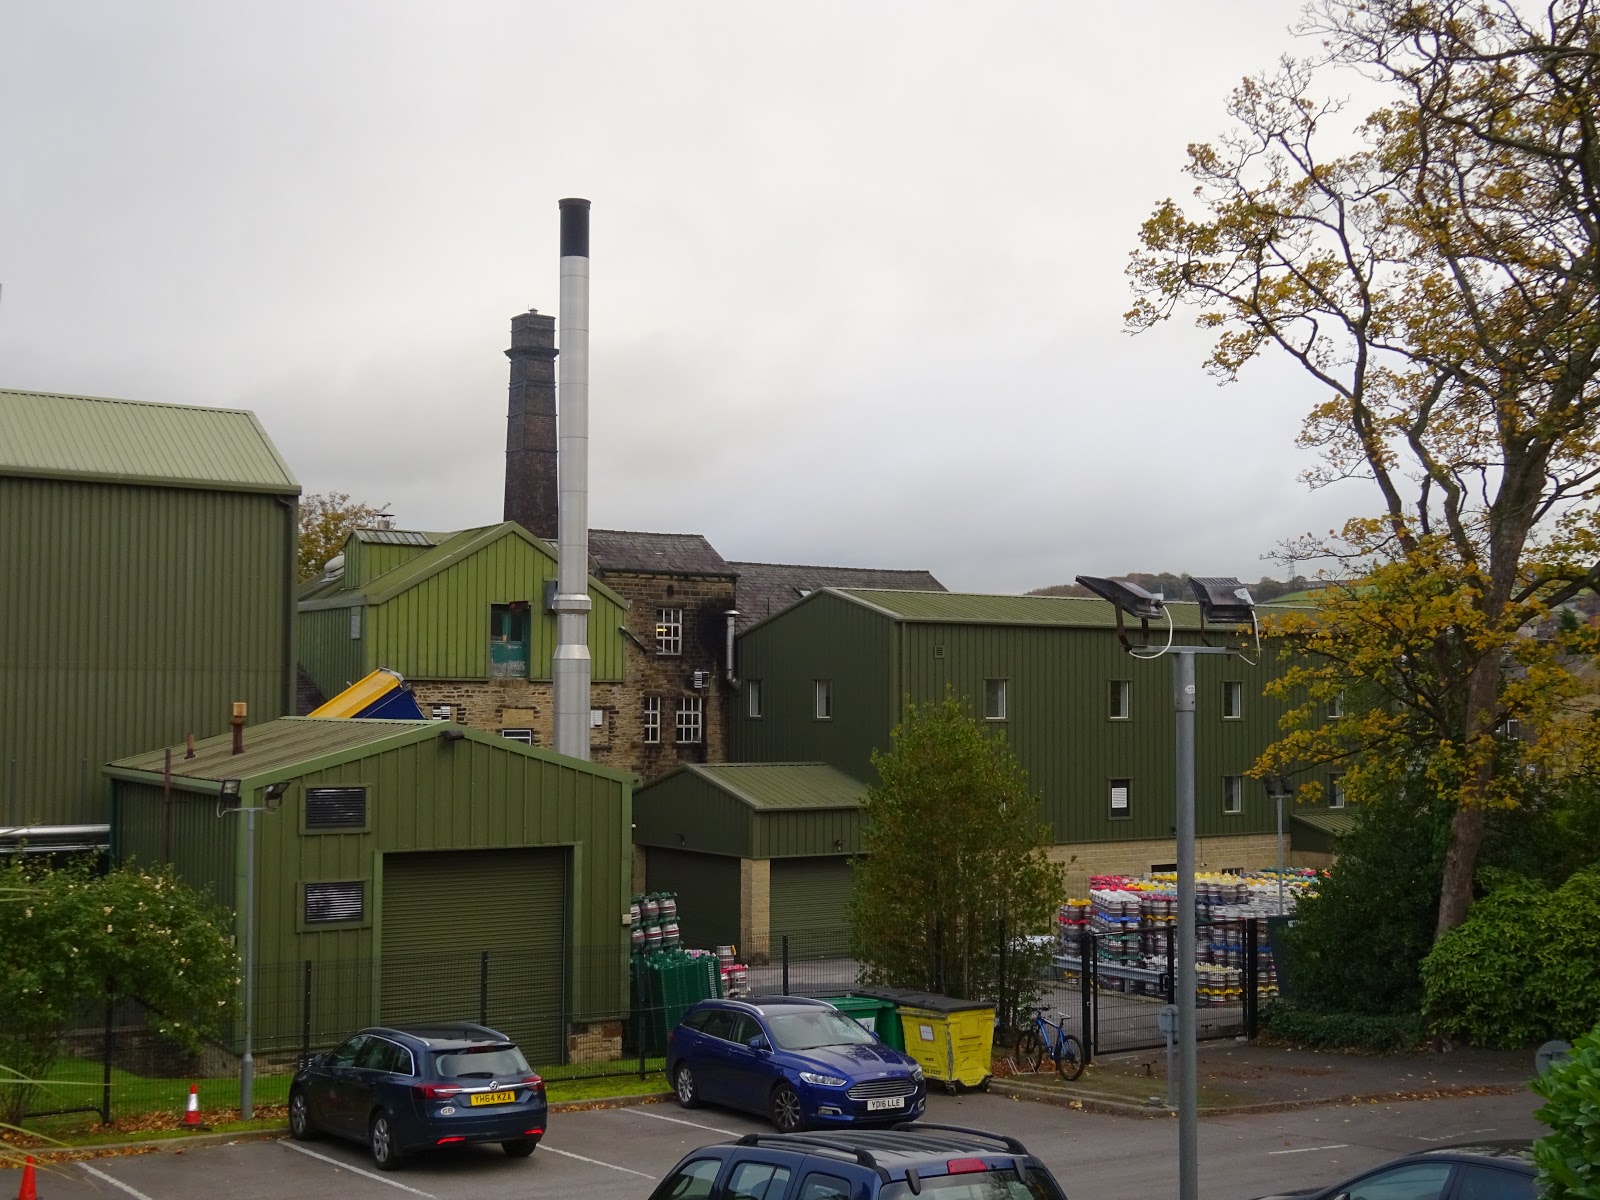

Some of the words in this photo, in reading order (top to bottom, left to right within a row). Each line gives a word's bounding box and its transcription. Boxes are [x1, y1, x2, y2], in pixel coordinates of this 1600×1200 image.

[474, 1093, 495, 1104] YH64
[497, 1092, 512, 1102] KZA
[888, 1099, 901, 1107] LLE
[442, 1107, 453, 1115] GB
